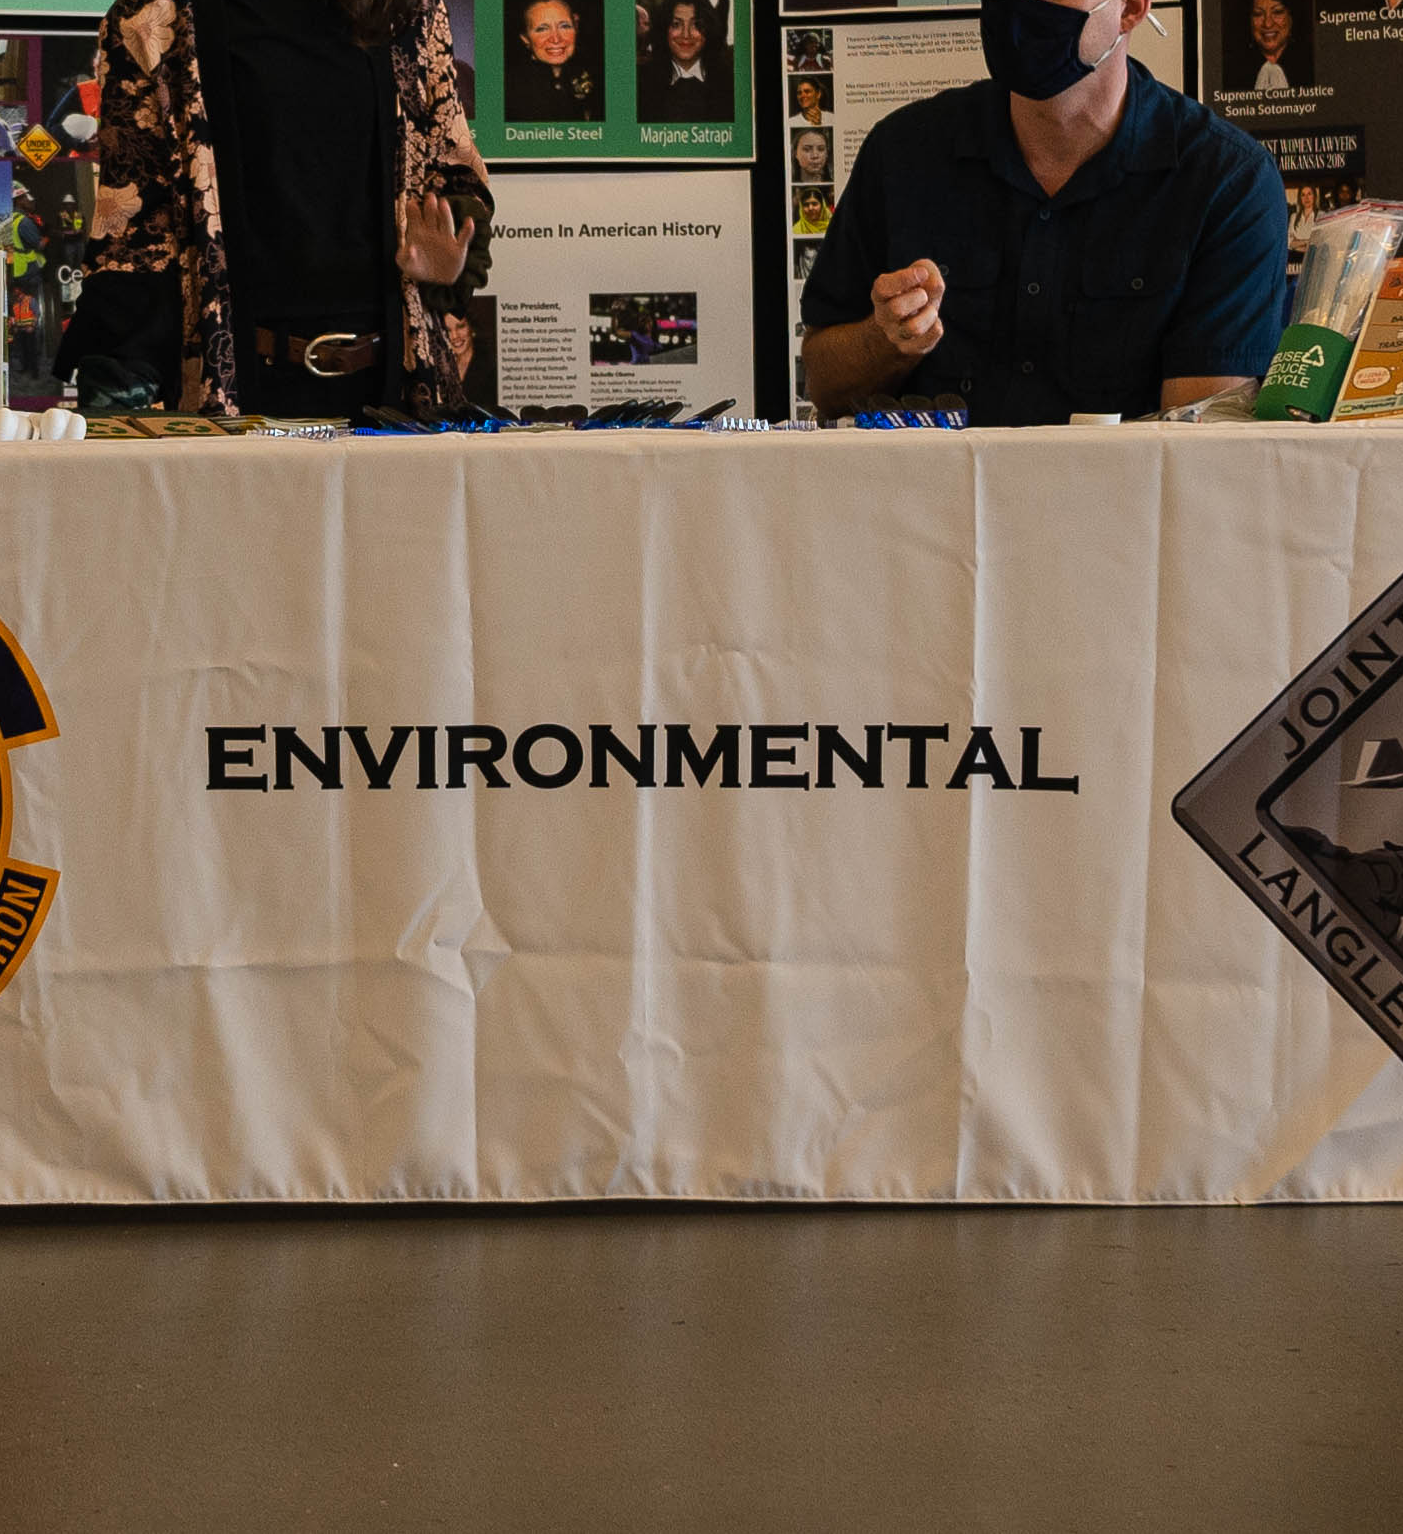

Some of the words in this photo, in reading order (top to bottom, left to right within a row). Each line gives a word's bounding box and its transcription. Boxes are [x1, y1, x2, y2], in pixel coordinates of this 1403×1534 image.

[1319, 9, 1377, 25] Supreme
[1345, 26, 1380, 41] Elena
[1225, 103, 1259, 117] Sonia
[1260, 101, 1317, 117] Sotomayor
[505, 127, 564, 141] Danielle
[568, 127, 603, 141] Steel
[640, 127, 688, 147] Marjane
[691, 126, 733, 146] Satrapi
[26, 140, 52, 148] UNDER
[1314, 135, 1357, 153] LAWYERS
[1327, 153, 1345, 168] 2018
[490, 224, 553, 239] Women
[558, 224, 573, 238] In
[578, 223, 657, 238] American
[662, 222, 722, 239] History
[204, 723, 1079, 795] ENVIRONMENTAL
